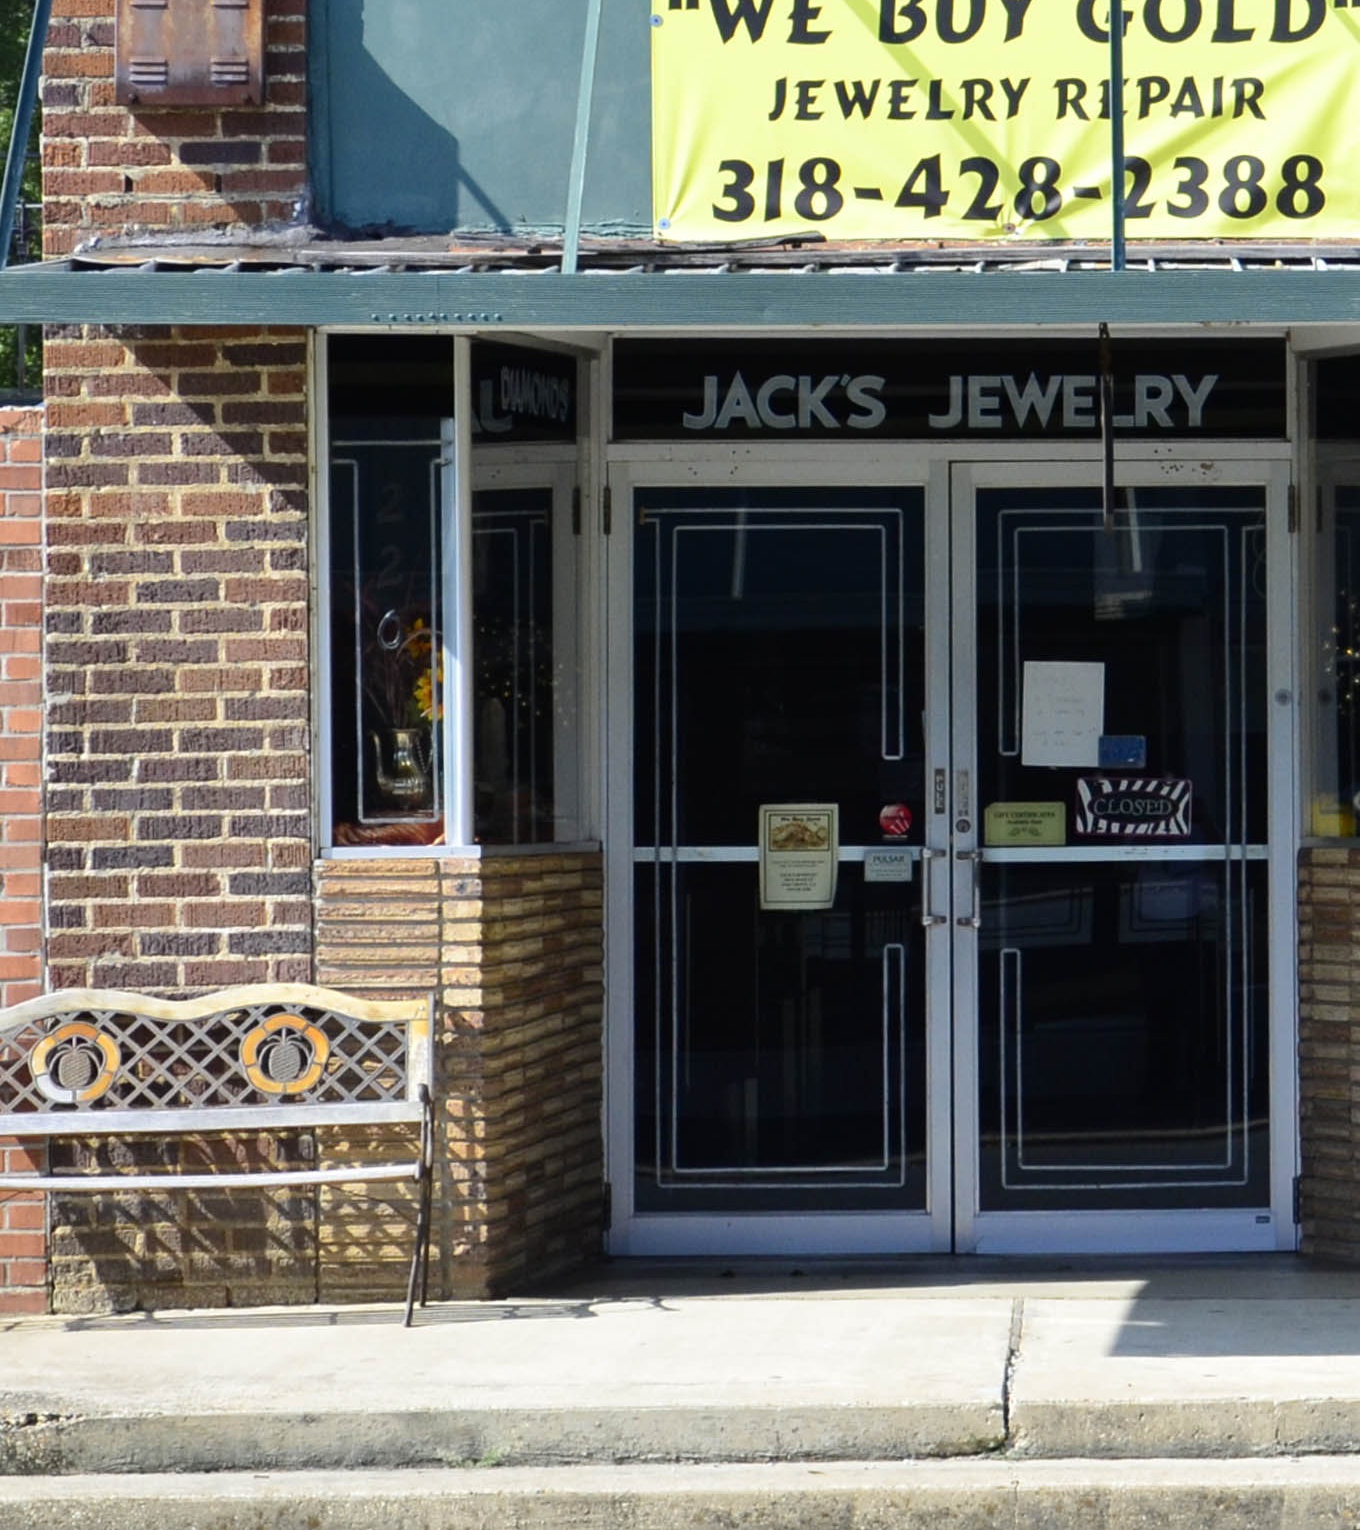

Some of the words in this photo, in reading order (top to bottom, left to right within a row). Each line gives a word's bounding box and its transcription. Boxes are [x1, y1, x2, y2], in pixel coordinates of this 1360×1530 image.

[767, 77, 1030, 121] JEWELRY
[711, 153, 1327, 224] 318-428-2388
[500, 365, 568, 423] DIAMONDS
[682, 370, 887, 430] JACK'S
[1093, 797, 1173, 816] CLOSED
